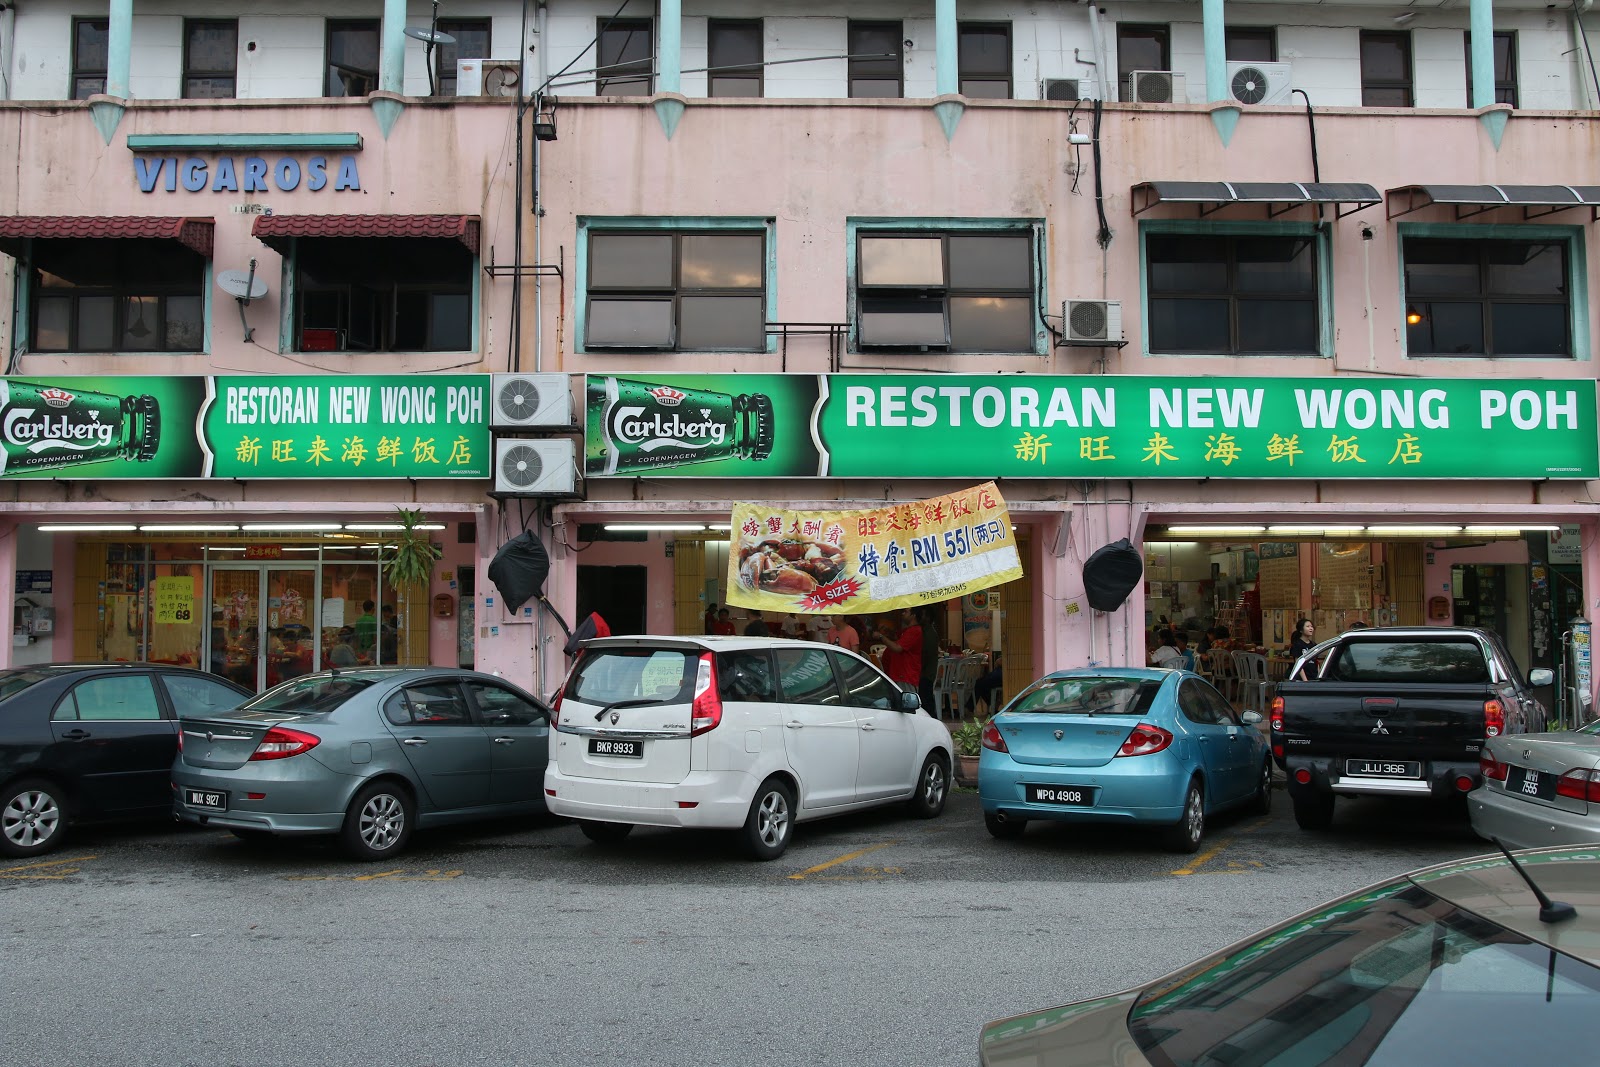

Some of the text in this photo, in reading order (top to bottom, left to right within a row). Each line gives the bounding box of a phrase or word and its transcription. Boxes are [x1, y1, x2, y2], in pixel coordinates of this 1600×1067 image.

[134, 157, 361, 193] VIGAROSA
[226, 386, 483, 424] RESTORAN NEW WONG POH
[846, 386, 1578, 430] RESTORAN NEW WONG POH
[4, 408, 114, 448] Carlsberg
[613, 406, 727, 446] Carlsberg
[26, 454, 84, 465] COPENHAGEN
[236, 435, 472, 467] 新旺来海鲜饭店
[637, 453, 697, 463] COPENHAGEN
[1014, 432, 1423, 466] 新旺来海鲜饭店
[911, 535, 941, 567] RM
[809, 583, 852, 606] XL SIZE
[175, 609, 191, 621] 68
[596, 740, 634, 754] BKR 9933
[1360, 763, 1406, 774] JLU 366
[1036, 788, 1082, 803] WPQ 4908
[1521, 780, 1539, 795] 7555
[205, 794, 220, 807] 9127
